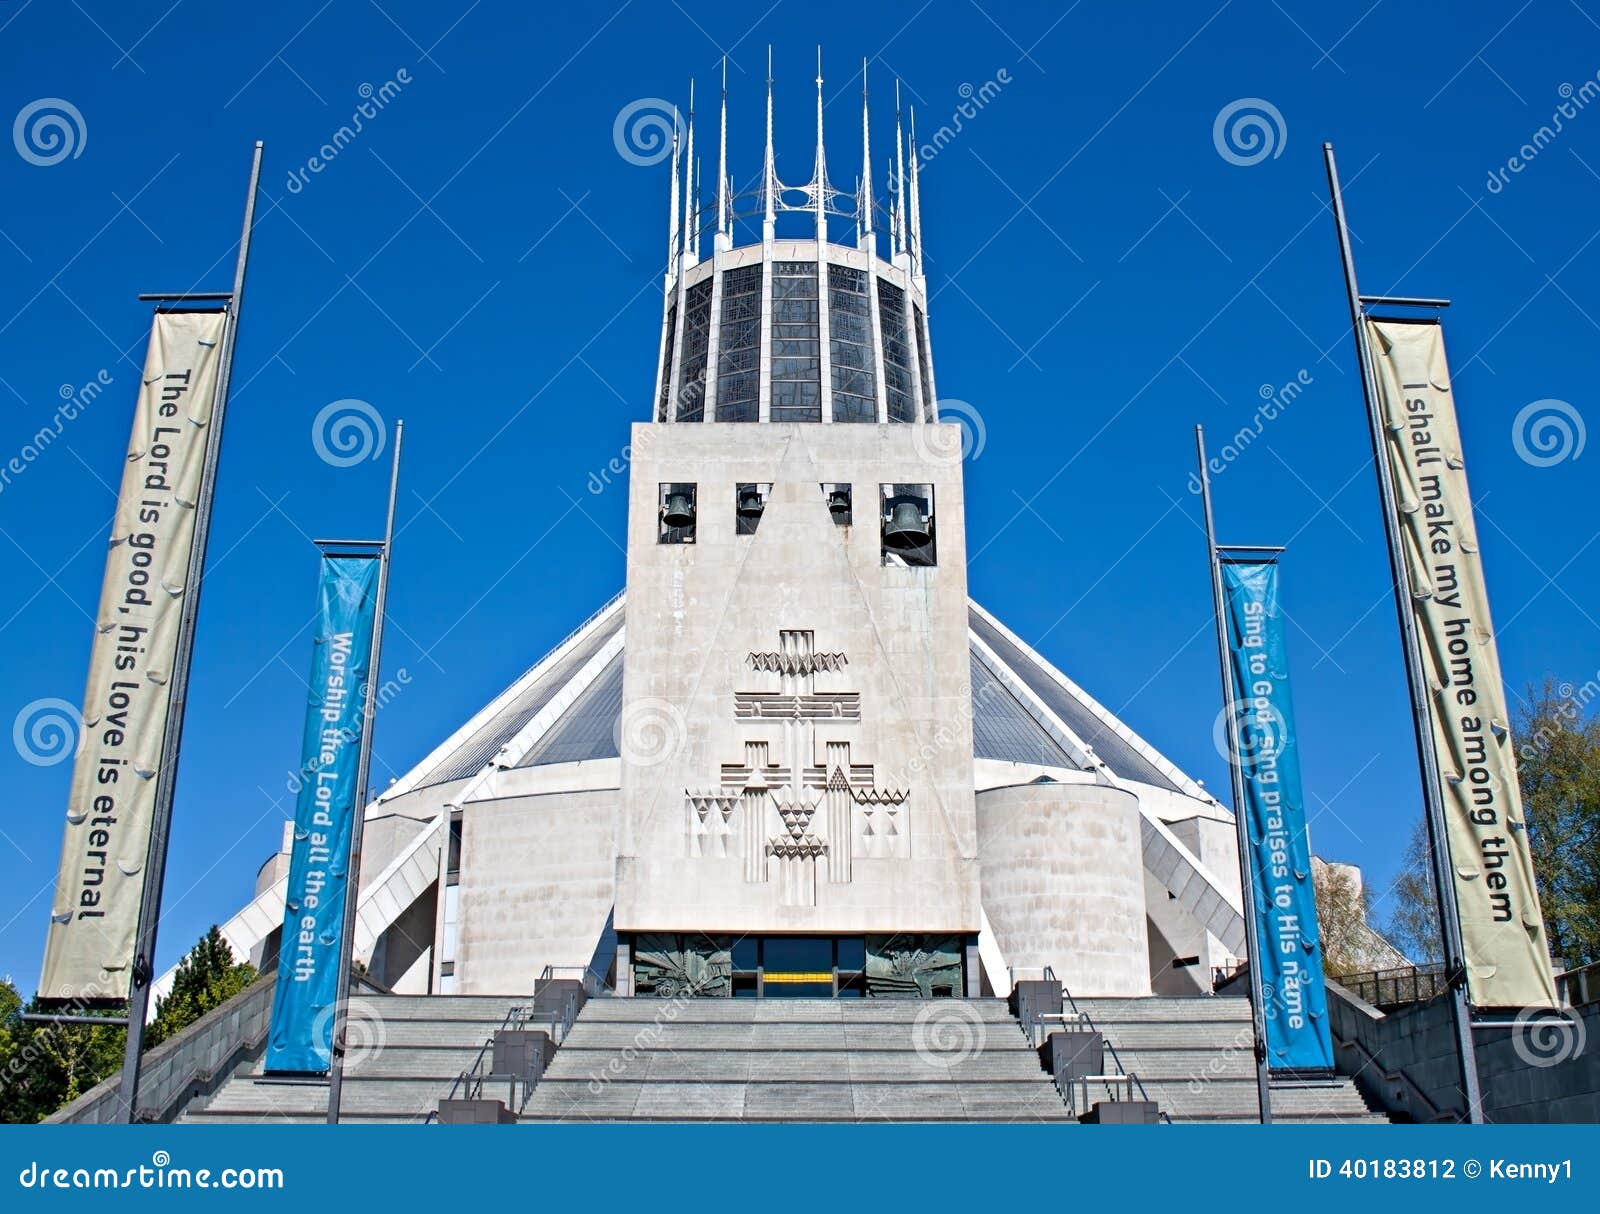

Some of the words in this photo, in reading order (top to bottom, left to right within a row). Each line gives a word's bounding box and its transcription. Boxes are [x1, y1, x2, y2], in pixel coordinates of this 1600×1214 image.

[158, 368, 191, 418] The
[145, 427, 181, 490] Lord
[1406, 398, 1441, 468] shall
[139, 500, 169, 524] is
[1418, 475, 1453, 555] make
[117, 533, 155, 614] good,
[1433, 564, 1462, 609] my
[115, 624, 148, 671] his
[1243, 602, 1263, 648] Sing
[320, 632, 353, 723] Worship
[1249, 652, 1266, 675] to
[1443, 618, 1477, 706] home
[103, 681, 139, 747] love
[98, 758, 128, 785] is
[319, 729, 343, 766] the
[1256, 736, 1279, 784] sing
[1460, 716, 1497, 826] among
[312, 772, 338, 827] Lord
[78, 796, 117, 921] eternal
[309, 833, 327, 864] all
[1260, 790, 1288, 879] praises
[303, 870, 326, 910] the
[1275, 884, 1293, 908] to
[1481, 835, 1513, 923] them
[295, 916, 316, 982] earth
[1277, 914, 1296, 954] His
[1282, 961, 1304, 1030] name
